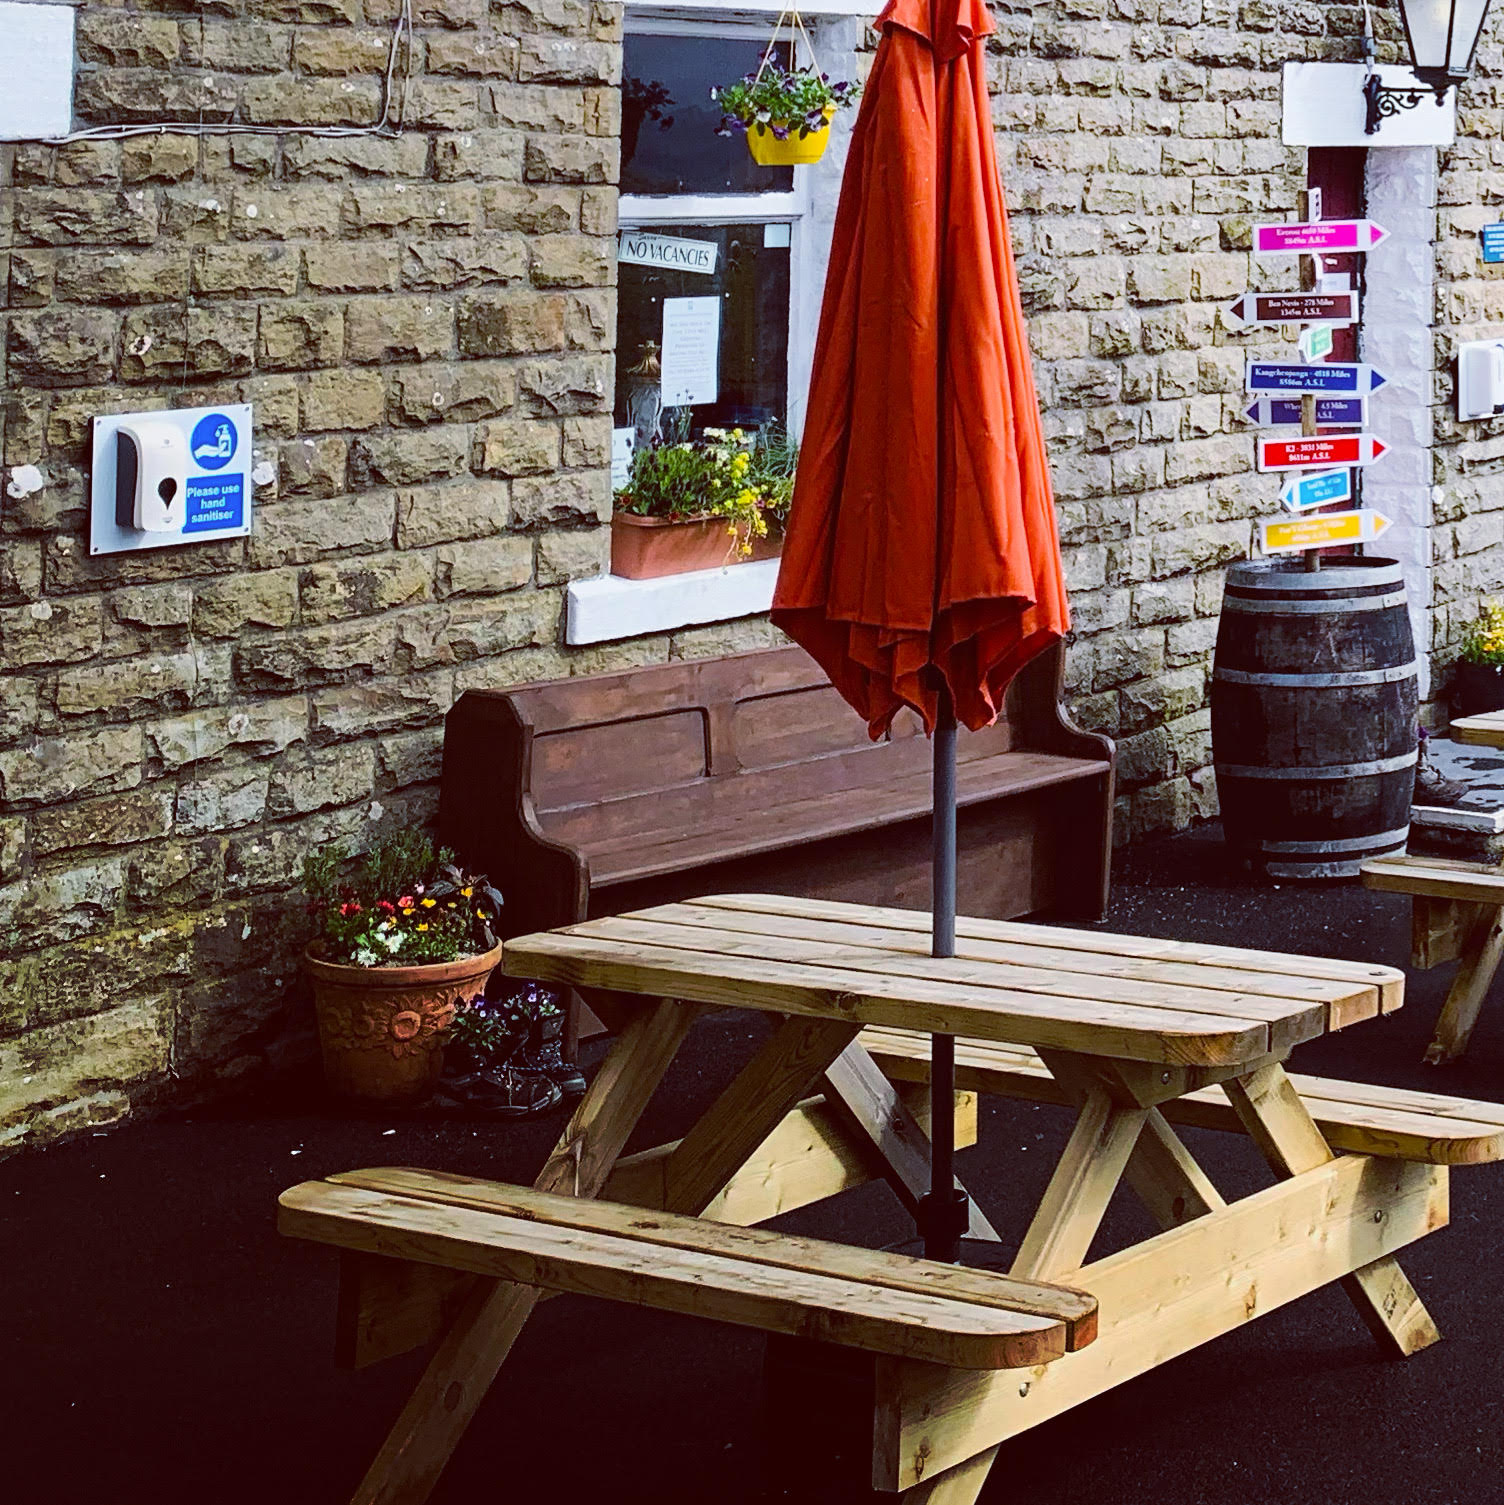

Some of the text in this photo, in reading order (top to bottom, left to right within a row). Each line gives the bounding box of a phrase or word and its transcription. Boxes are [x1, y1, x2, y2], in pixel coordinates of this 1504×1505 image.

[626, 240, 710, 267] NO VACANCIES
[187, 483, 240, 499] Please use
[200, 497, 226, 509] hand
[191, 509, 234, 523] sanitiser
